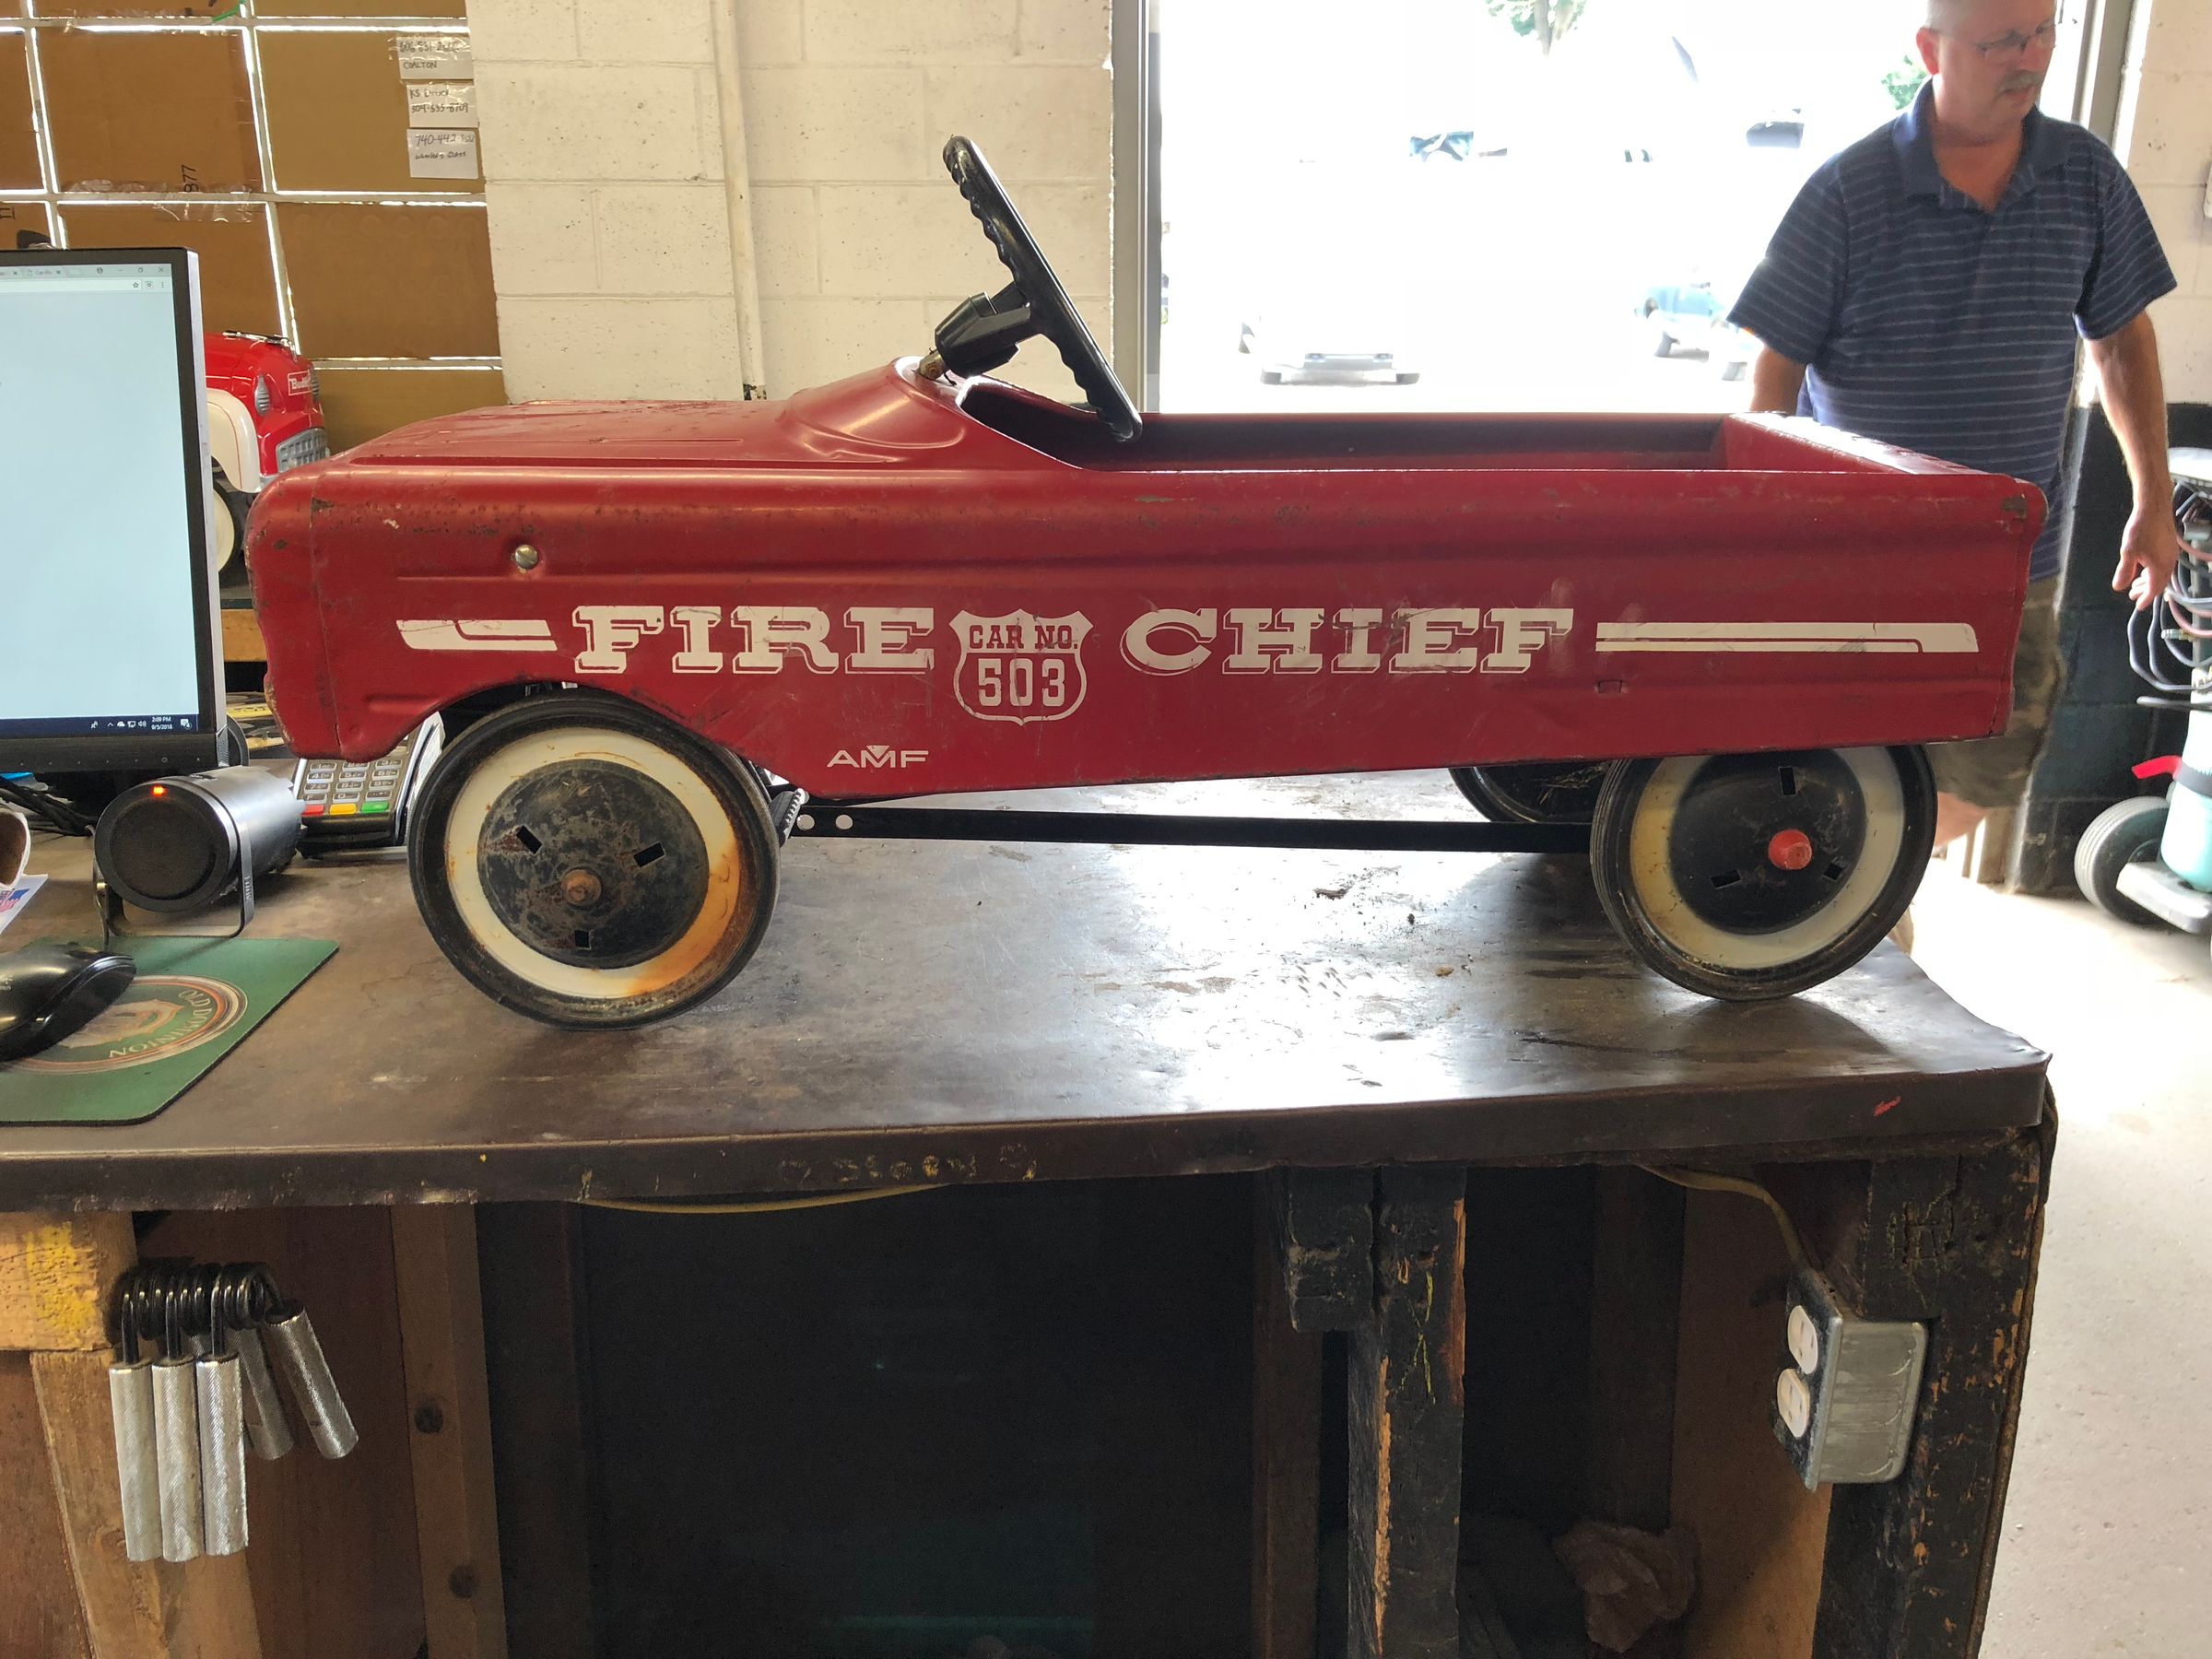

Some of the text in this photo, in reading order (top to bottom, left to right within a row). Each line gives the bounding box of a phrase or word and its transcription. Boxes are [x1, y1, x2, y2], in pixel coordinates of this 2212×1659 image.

[571, 605, 1574, 677] FIRE CHIEF
[969, 623, 1078, 650] CAR NO.
[978, 657, 1066, 708] 503
[827, 745, 929, 769] AMF
[109, 989, 214, 1059] OLD DOMINION
